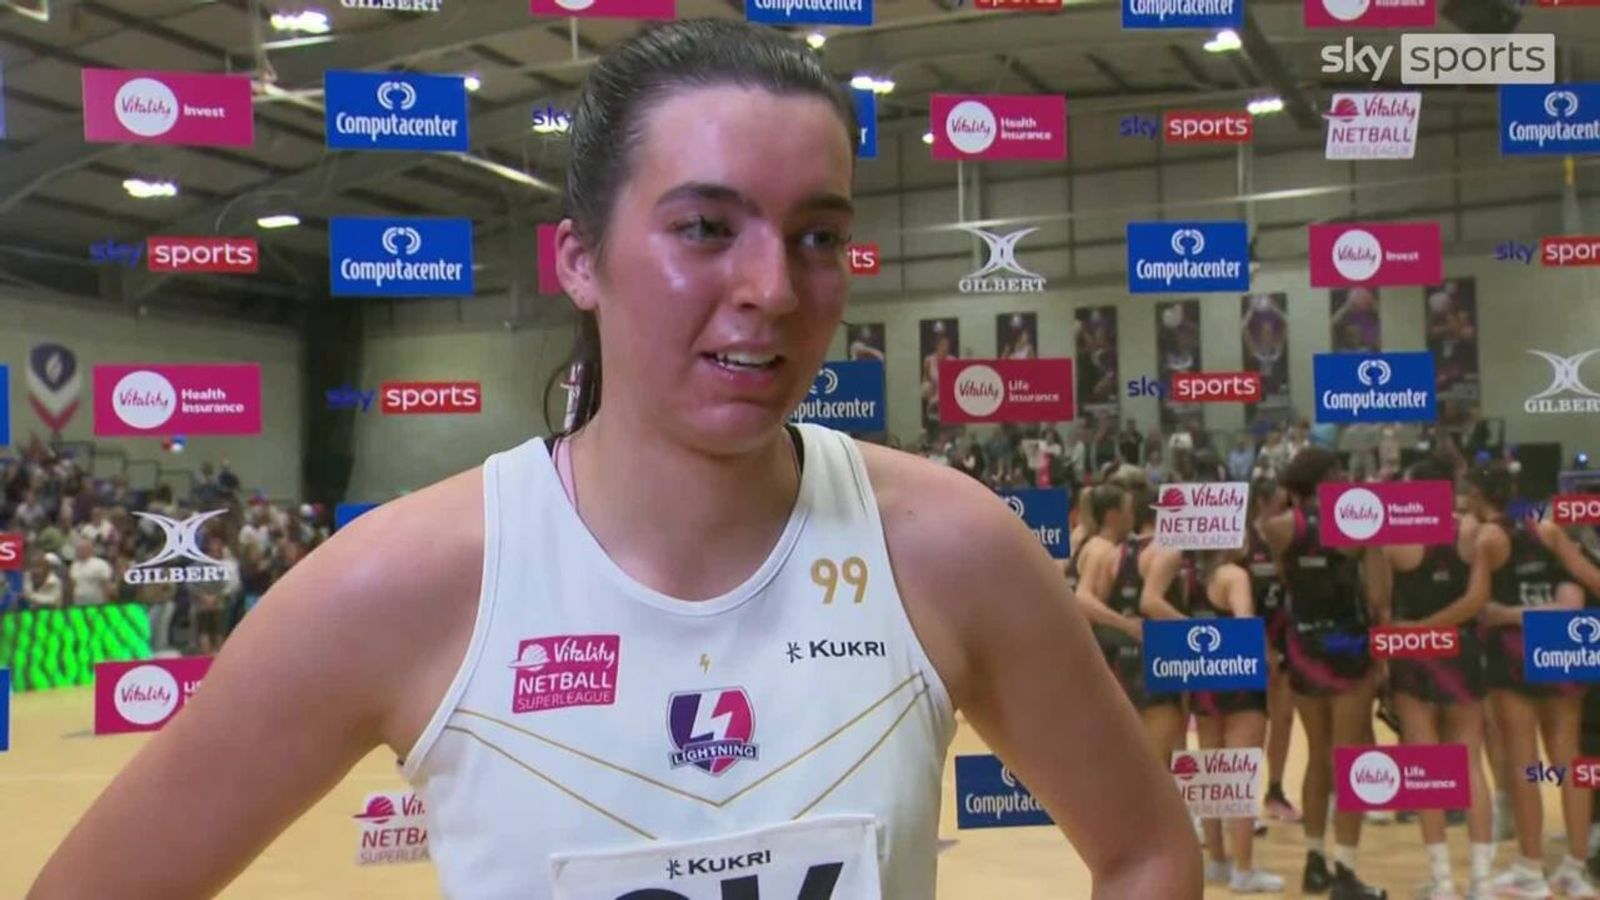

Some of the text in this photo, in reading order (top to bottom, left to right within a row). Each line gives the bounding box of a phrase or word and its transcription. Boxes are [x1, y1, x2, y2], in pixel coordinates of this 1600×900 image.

[121, 95, 171, 118] Vitality
[184, 105, 226, 118] Invest
[1365, 96, 1416, 123] Vitality
[336, 112, 458, 141] Computacenter
[951, 115, 991, 138] Vitality
[1001, 118, 1037, 128] Health
[1120, 114, 1248, 140] sky sports
[1509, 120, 1600, 147] Computacent
[1001, 130, 1052, 140] Insurance
[1332, 127, 1412, 143] NETBALL
[90, 235, 252, 270] sky sports
[1337, 244, 1377, 264] Vitality
[1386, 251, 1419, 261] Invest
[1495, 241, 1537, 265] sky
[341, 258, 463, 287] Computacenter
[1136, 258, 1241, 286] Computacenter
[958, 278, 1047, 293] GILBERT
[181, 388, 226, 400] Health
[959, 379, 1000, 401] Vitality
[1009, 380, 1030, 391] Life
[1178, 377, 1256, 399] sports
[119, 388, 169, 410] Vitality
[181, 401, 245, 413] Insurance
[386, 386, 478, 410] sports
[1009, 392, 1060, 402] Insurance
[1323, 388, 1428, 416] Computacenter
[1191, 482, 1244, 512] Vitality
[1339, 504, 1379, 524] Vitality
[1388, 503, 1424, 514] Health
[1160, 517, 1241, 533] NETBALL
[1388, 515, 1439, 526] Insurance
[124, 566, 234, 584] GILBERT
[811, 556, 869, 604] 99
[809, 639, 887, 658] KUKRI
[1374, 630, 1455, 654] sports
[554, 638, 615, 669] Vitality
[1152, 655, 1259, 684] Computacenter
[519, 671, 613, 695] NETBALL
[121, 683, 171, 706] Vitality
[518, 690, 611, 711] SUPERLEAGUE
[672, 744, 756, 765] LIGHTNING
[1204, 752, 1257, 780] Vitality
[1404, 766, 1426, 777] Life
[1526, 761, 1567, 787] sky
[1355, 768, 1395, 788] Vitality
[1404, 779, 1457, 789] Insurance
[688, 850, 771, 875] KUKRI
